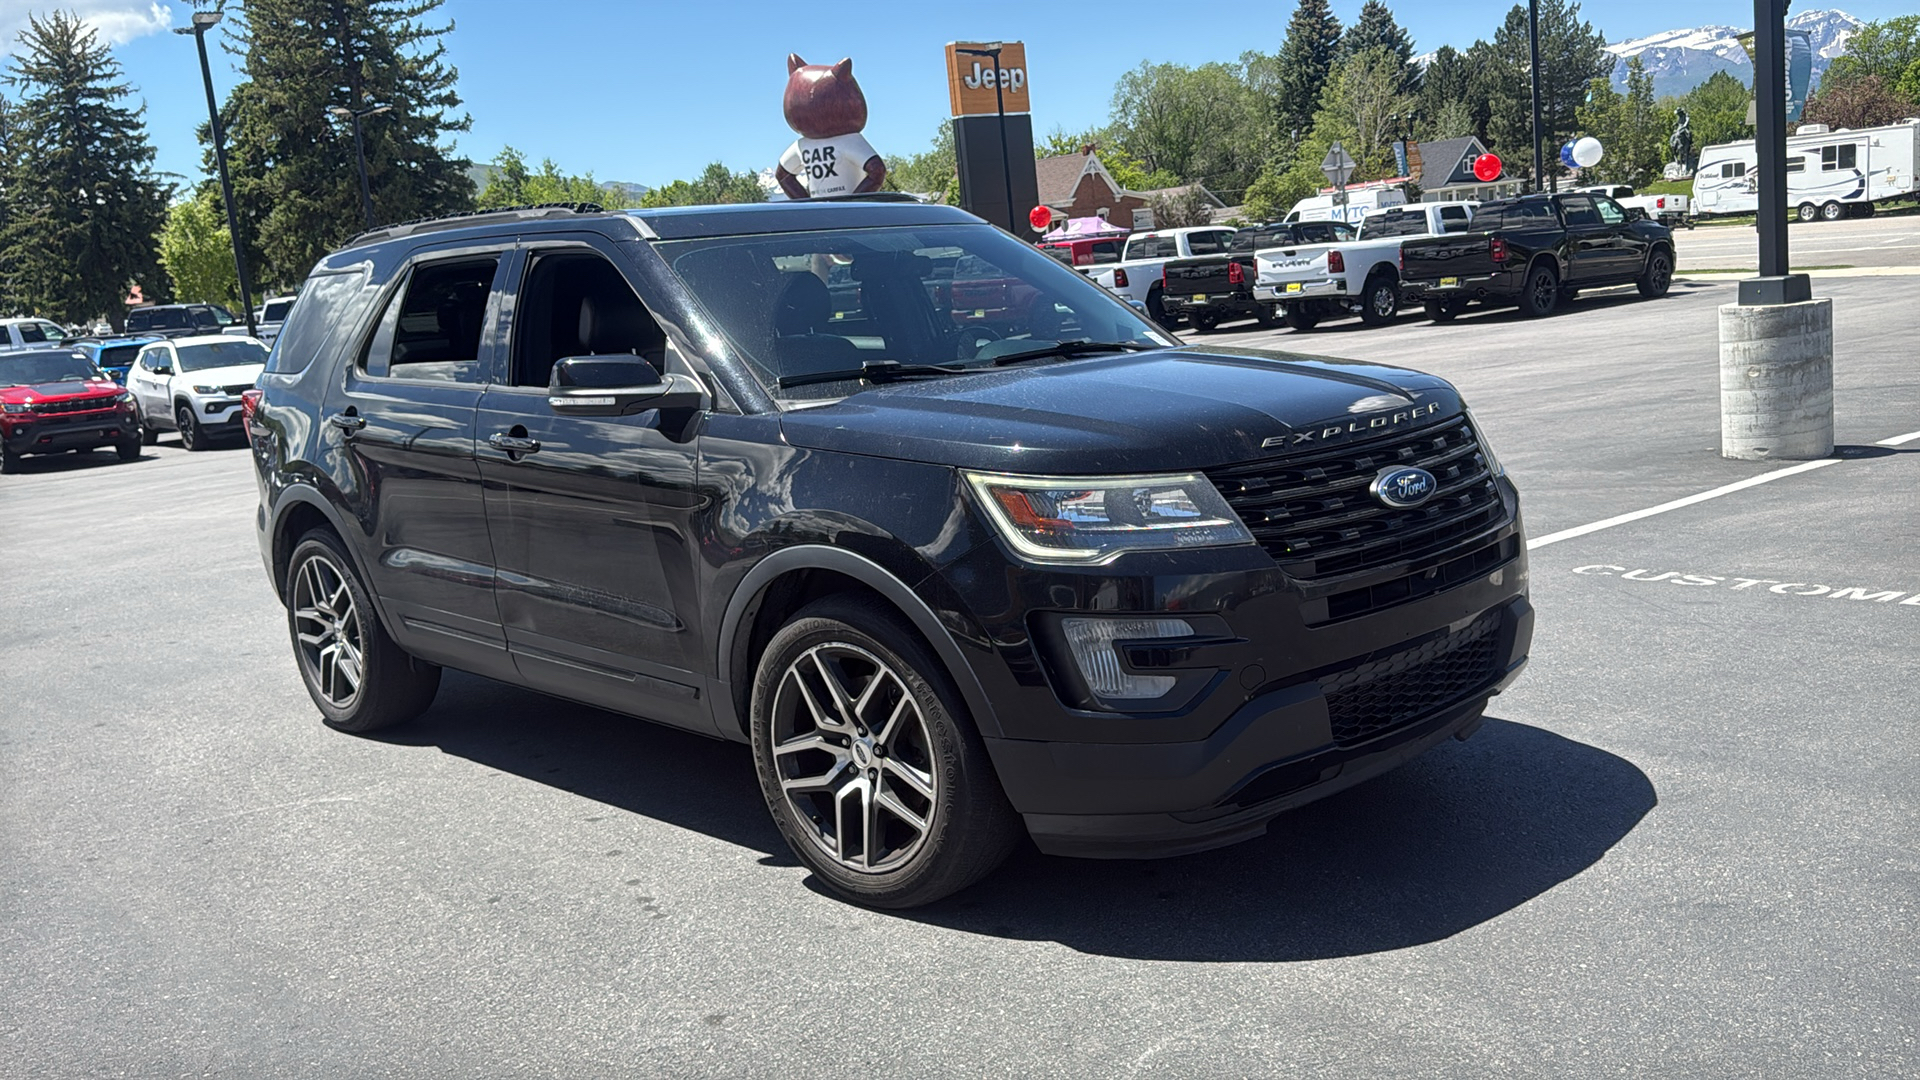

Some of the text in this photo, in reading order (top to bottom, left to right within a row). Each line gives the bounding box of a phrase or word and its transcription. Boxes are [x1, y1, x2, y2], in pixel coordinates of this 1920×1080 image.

[964, 62, 1025, 93] Jeep
[802, 145, 836, 165] CAR
[805, 161, 839, 180] FOX
[1424, 249, 1465, 259] RAM
[1180, 270, 1211, 279] RAM
[1261, 401, 1441, 448] EXPLORER
[1396, 474, 1429, 498] Ford
